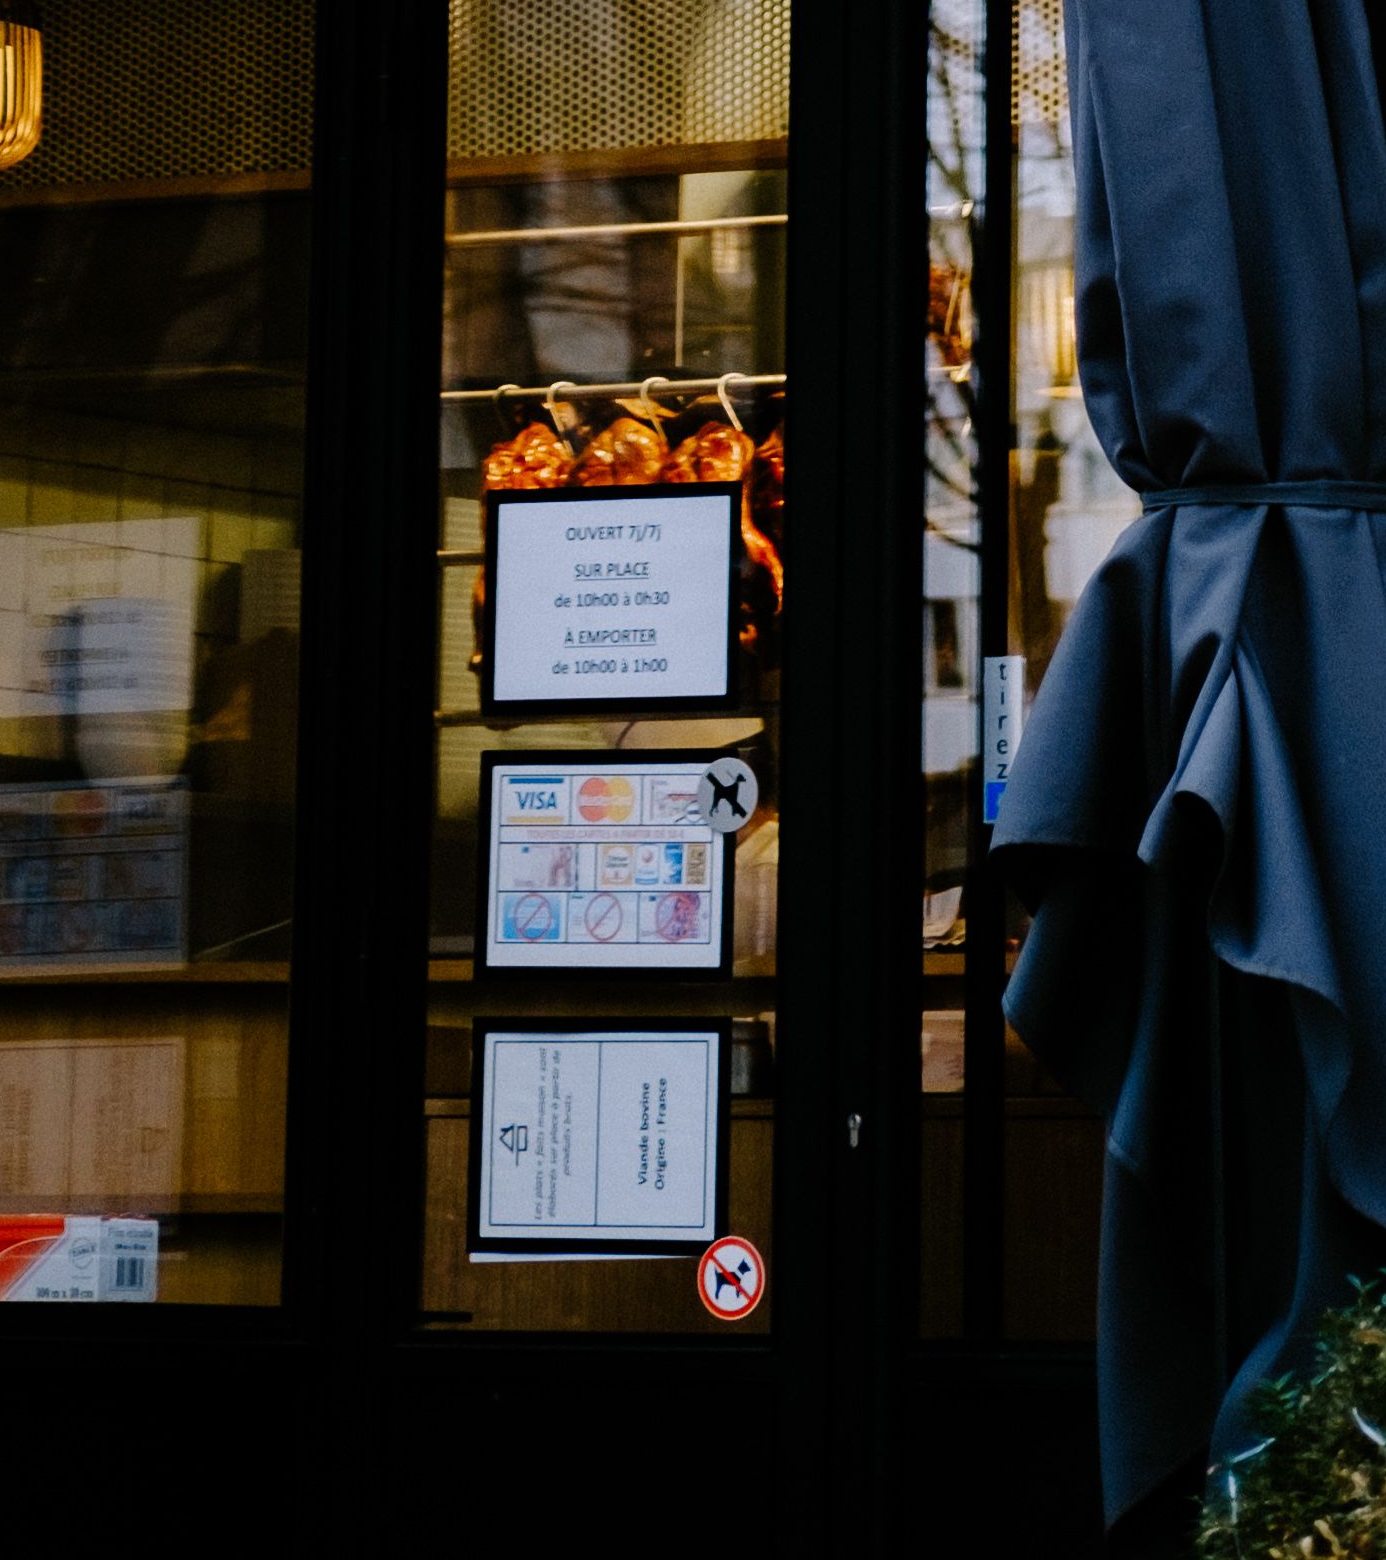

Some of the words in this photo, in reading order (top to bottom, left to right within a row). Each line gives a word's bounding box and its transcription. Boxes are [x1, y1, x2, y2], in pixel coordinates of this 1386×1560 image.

[565, 525, 624, 542] OUVERT
[628, 523, 662, 542] 7j/7j
[574, 562, 602, 578] SUR
[606, 561, 650, 577] PLACE
[554, 593, 571, 608] de
[576, 591, 619, 607] 10h00
[623, 591, 631, 606] à
[635, 590, 670, 606] 0h30
[578, 628, 657, 644] EMPORTER
[551, 659, 569, 675] de
[574, 658, 617, 674] 10h00
[620, 659, 629, 673] à
[634, 657, 669, 673] 1h00
[995, 662, 1009, 780] tirez
[514, 790, 559, 811] VISA
[638, 1081, 650, 1131] bovine
[655, 1077, 667, 1125] France
[637, 1134, 649, 1185] Viande
[654, 1137, 668, 1191] Origine
